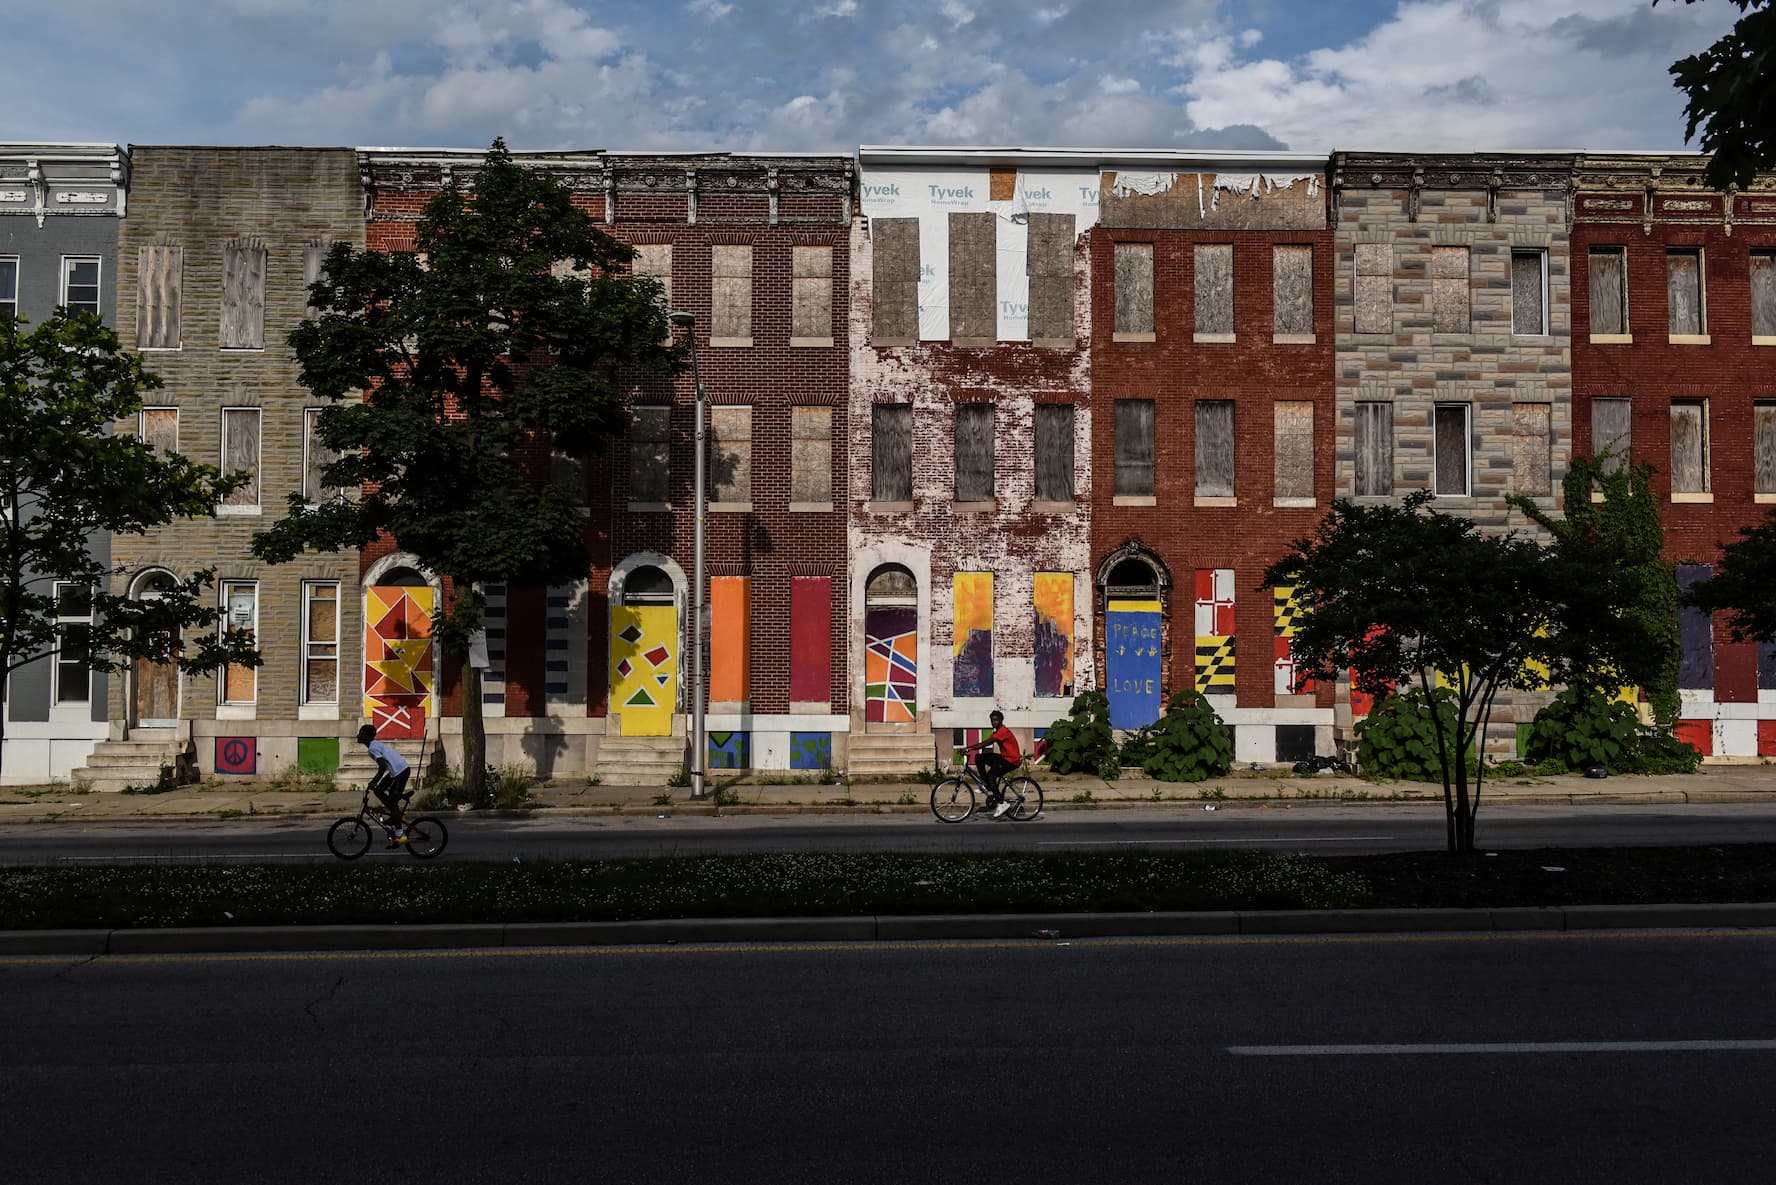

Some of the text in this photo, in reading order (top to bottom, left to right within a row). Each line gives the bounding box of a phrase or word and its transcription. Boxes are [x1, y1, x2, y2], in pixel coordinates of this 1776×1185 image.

[928, 185, 974, 200] Tyvek
[1024, 187, 1052, 200] vek
[1000, 301, 1028, 315] Tyv
[1113, 623, 1157, 640] PEACE
[1113, 678, 1155, 695] LOVE
